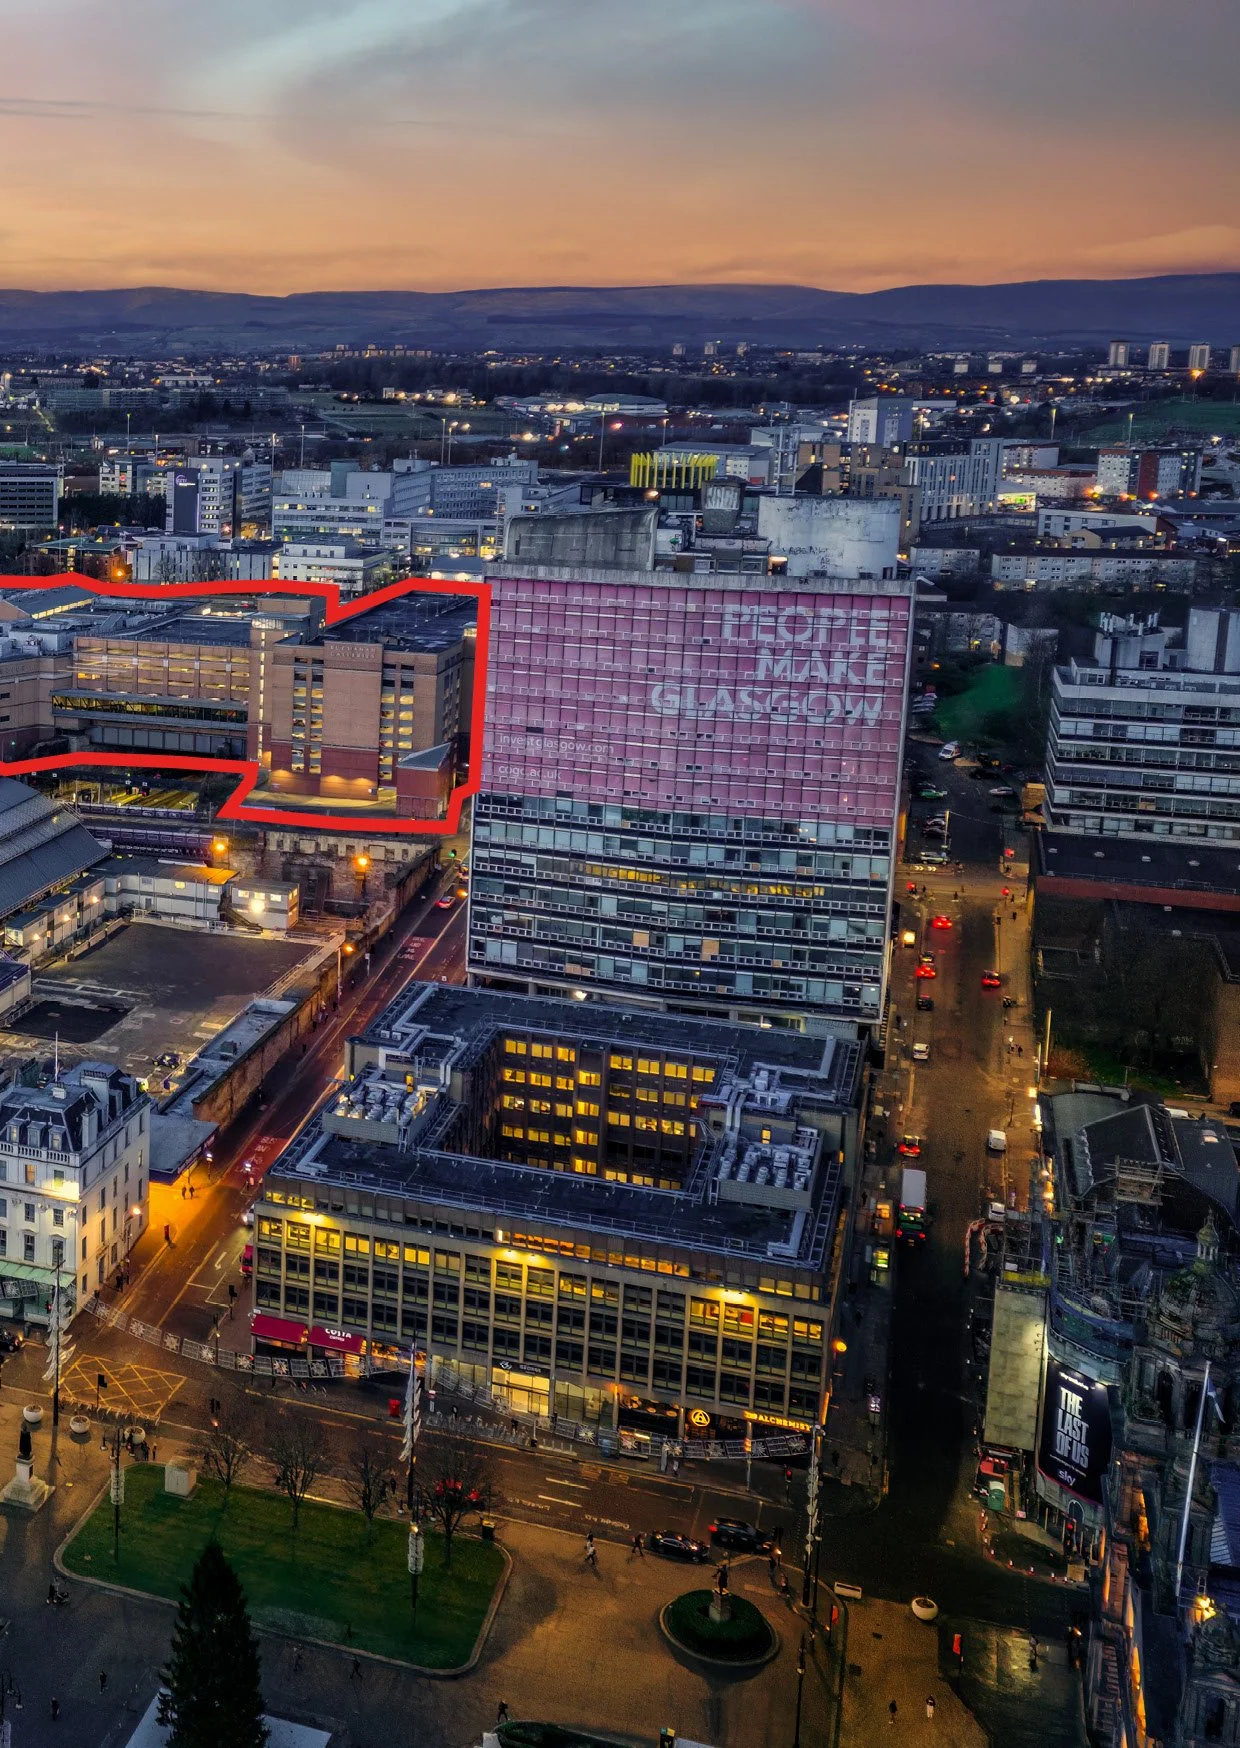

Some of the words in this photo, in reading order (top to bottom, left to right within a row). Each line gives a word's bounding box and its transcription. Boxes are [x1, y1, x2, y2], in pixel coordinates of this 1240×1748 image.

[722, 604, 892, 647] PEOPLE
[757, 648, 891, 686] MAKE
[651, 682, 886, 726] GLASGOW
[500, 733, 615, 755] investglasgow.com
[498, 765, 562, 779] cogc.ac.uk
[325, 1328, 352, 1338] COSTA
[1060, 1387, 1083, 1419] THE
[759, 1415, 811, 1431] ALCHEMIST
[1057, 1408, 1090, 1444] LAST
[1056, 1430, 1072, 1458] OF
[1072, 1440, 1090, 1469] US
[1058, 1469, 1076, 1486] sky
